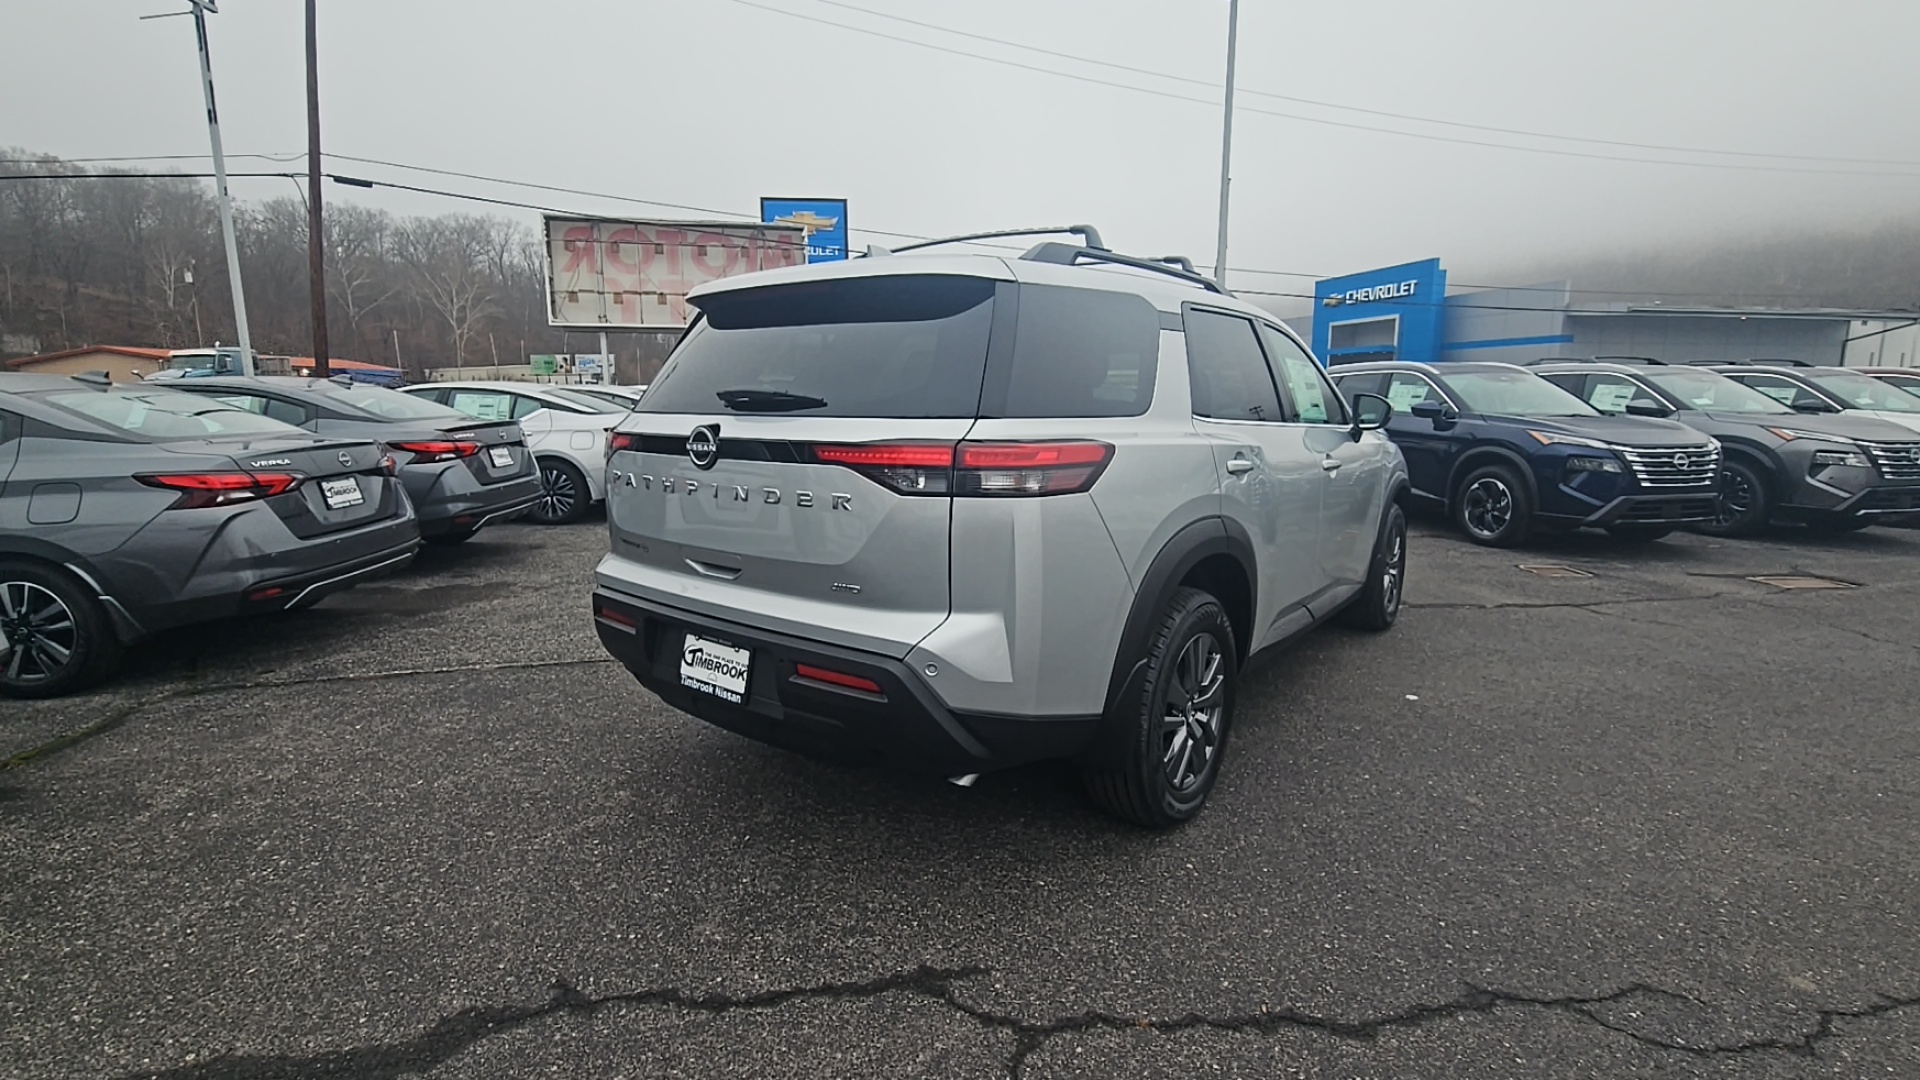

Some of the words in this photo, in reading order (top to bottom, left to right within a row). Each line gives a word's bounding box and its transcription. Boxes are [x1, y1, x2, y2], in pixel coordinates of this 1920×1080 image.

[1345, 280, 1418, 304] CHEVROLET
[686, 443, 716, 451] NISSAN
[251, 459, 291, 467] VERSA
[612, 469, 852, 511] PATHFINDER
[683, 645, 748, 681] TIMBROOK
[681, 675, 714, 694] Timbrook
[715, 686, 741, 703] Nissan
